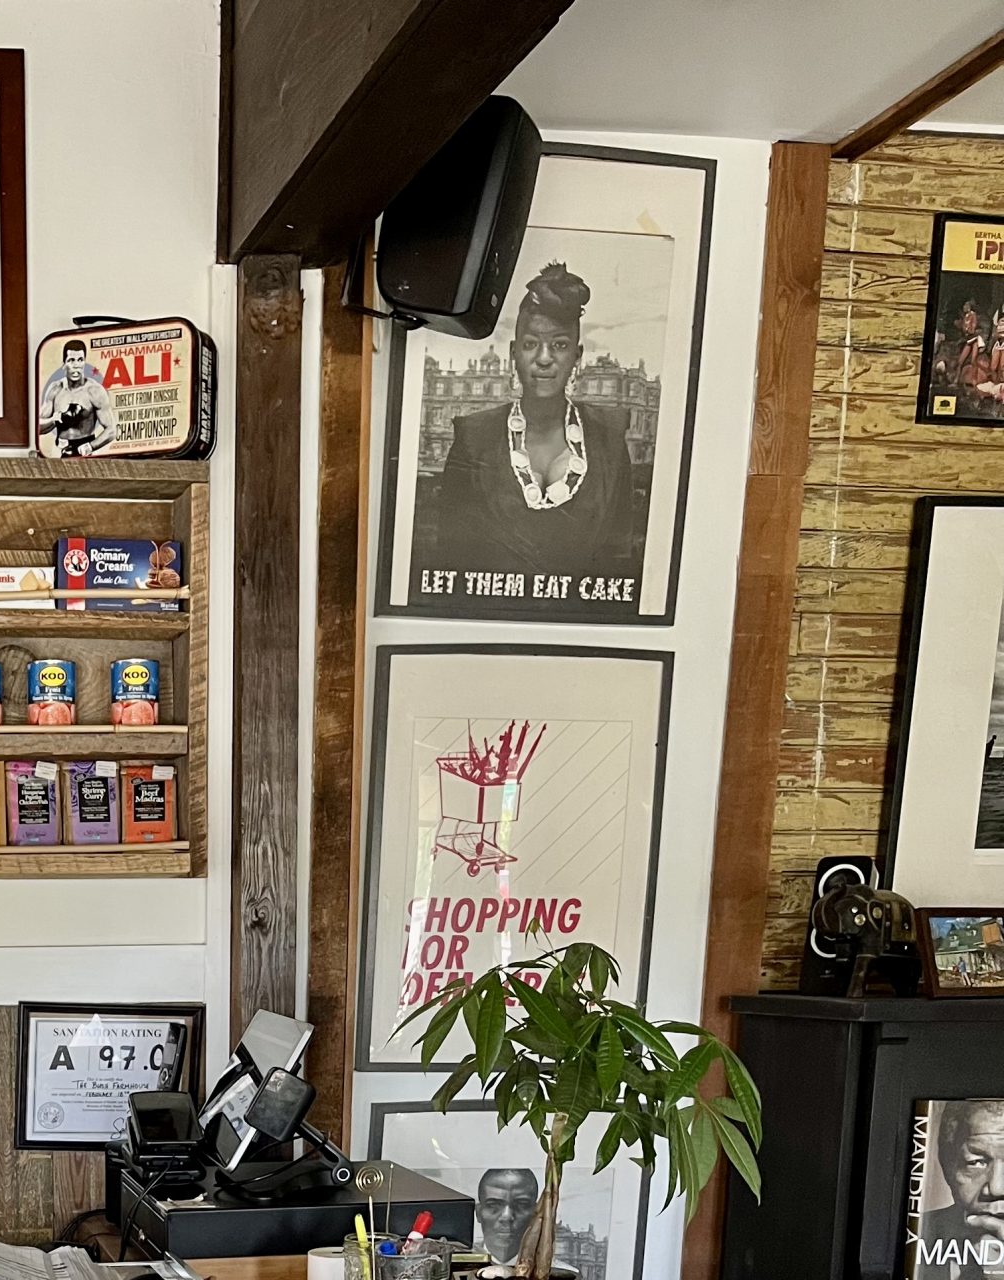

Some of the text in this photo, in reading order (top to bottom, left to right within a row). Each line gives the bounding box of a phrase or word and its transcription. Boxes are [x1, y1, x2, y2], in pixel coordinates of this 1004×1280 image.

[100, 343, 173, 359] MUHAMMAD
[101, 352, 171, 389] ALI
[115, 388, 179, 407] DIRECT FROM RINGSIDE
[118, 405, 174, 422] WORLD HEAVYWEIGHT
[115, 418, 177, 441] CHAMPIONSHIP
[199, 411, 209, 443] MAY
[90, 548, 130, 563] Romany
[95, 561, 134, 572] Creams
[93, 574, 113, 585] Classic
[421, 569, 635, 602] LET THEM EAT CAKE
[124, 671, 148, 679] KOO
[81, 787, 106, 795] Shrimp
[84, 793, 105, 803] Curry
[135, 795, 164, 803] Madras
[402, 934, 470, 971] OR
[121, 1027, 162, 1038] RATING
[49, 1045, 75, 1071] A
